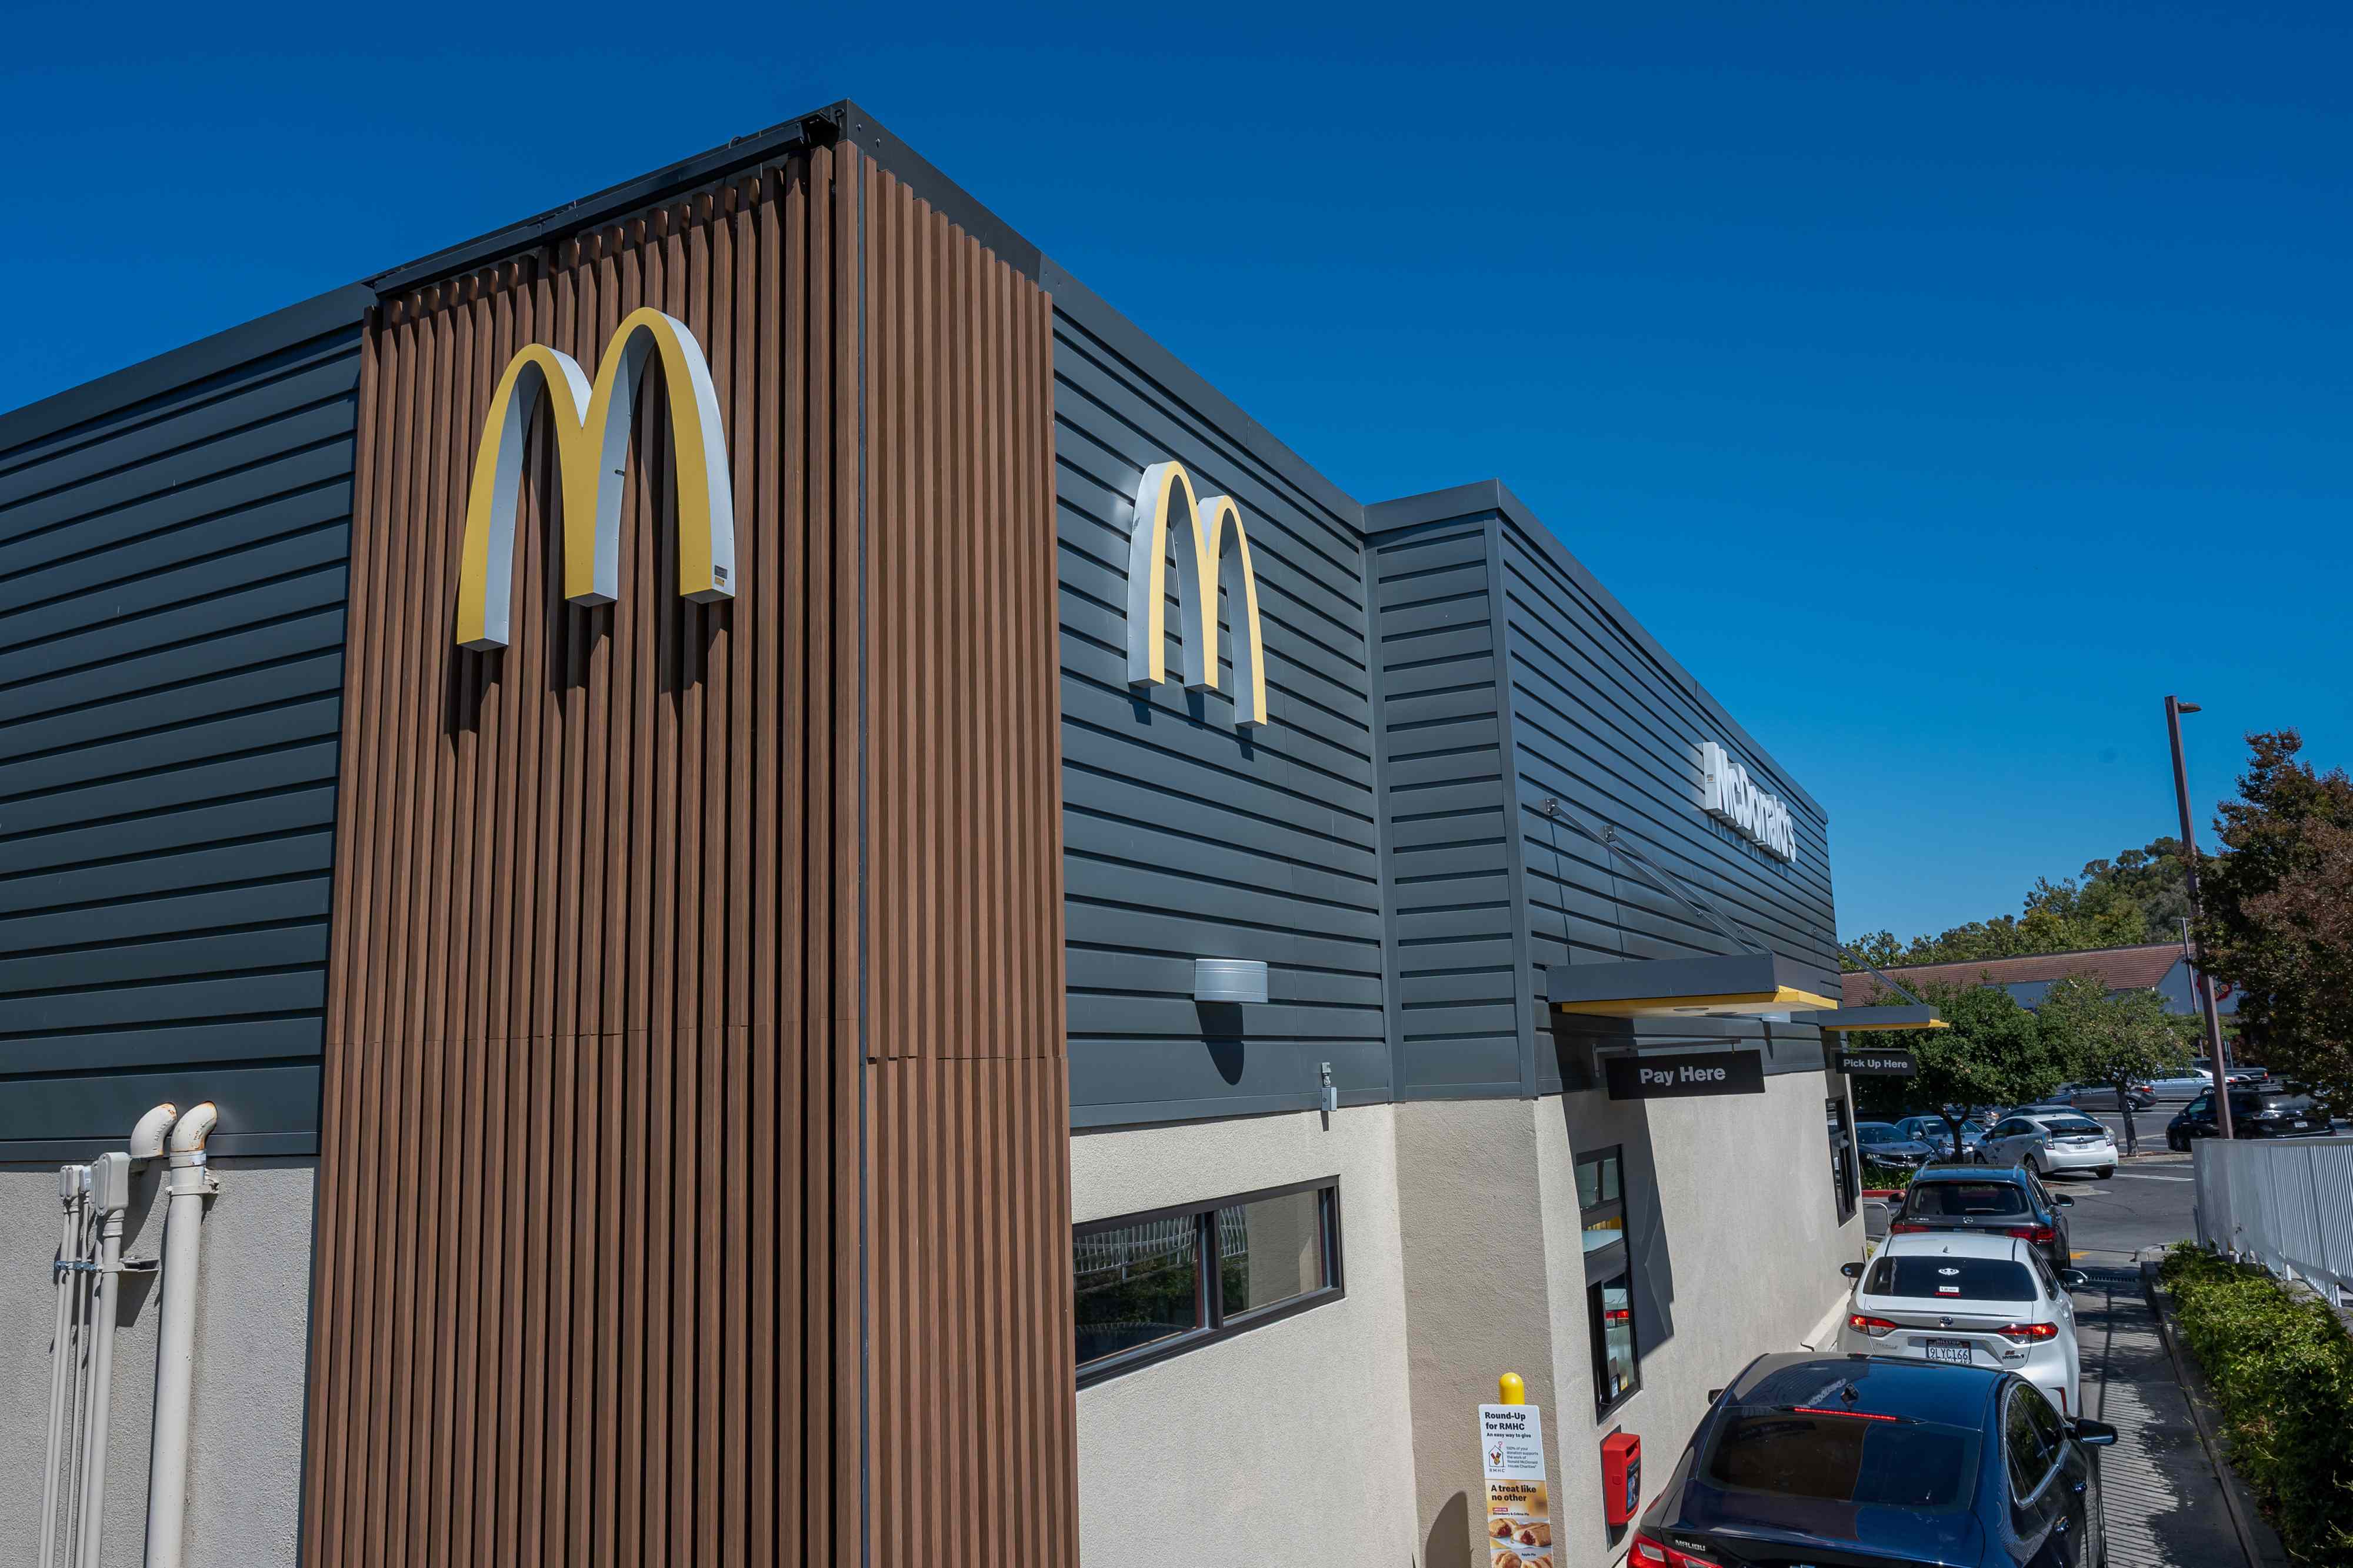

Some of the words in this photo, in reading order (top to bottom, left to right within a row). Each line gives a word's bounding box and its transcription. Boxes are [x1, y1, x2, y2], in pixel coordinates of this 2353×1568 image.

[1843, 1059, 1865, 1067] Pick
[1867, 1059, 1881, 1069] Up
[1884, 1060, 1908, 1068] Here
[1639, 1068, 1674, 1086] Pay
[1679, 1066, 1727, 1082] Here
[1929, 1347, 1968, 1360] 9LYC166
[1484, 1412, 1526, 1421] Round-Up
[1675, 1539, 1705, 1551] MALIBU
